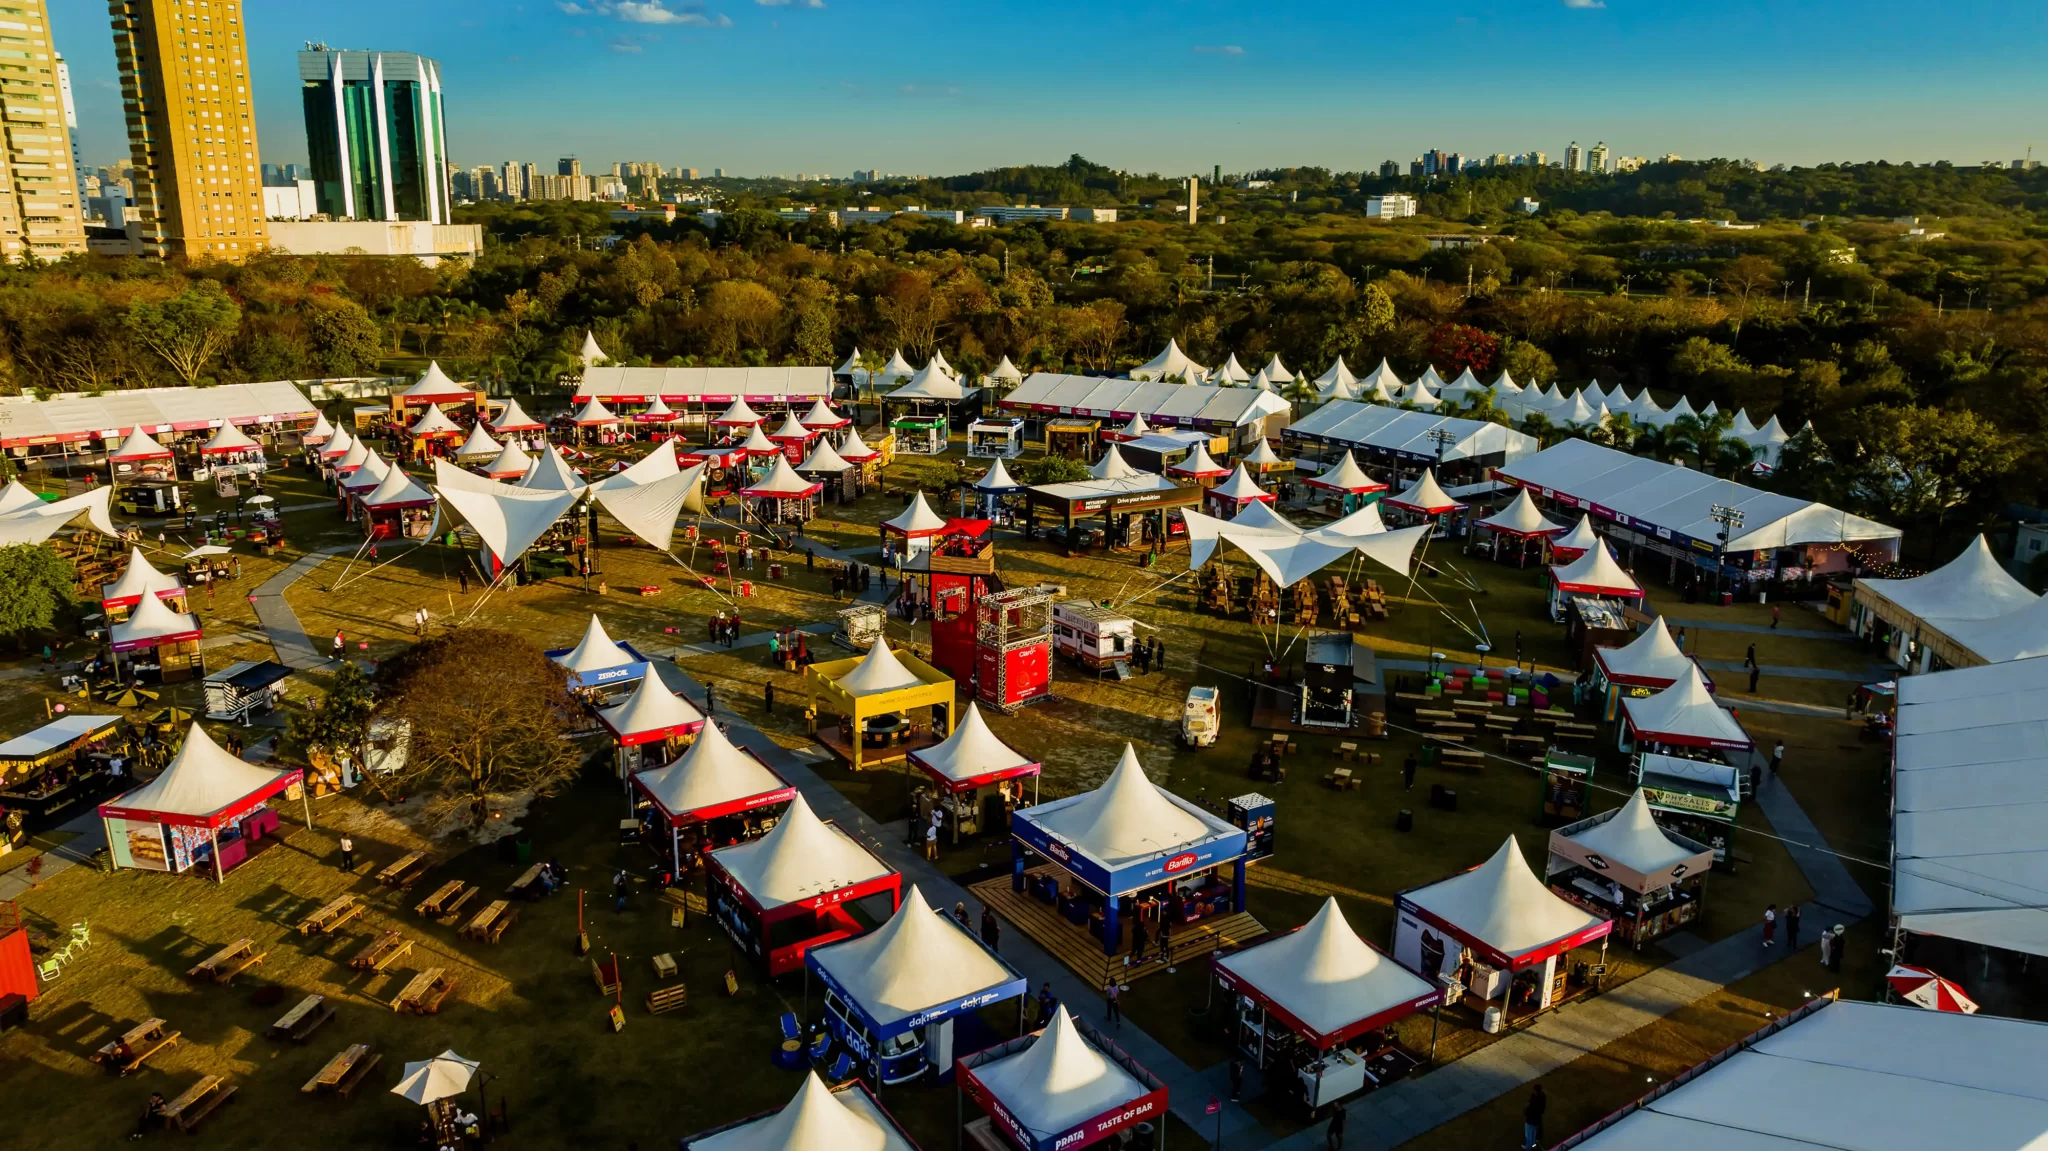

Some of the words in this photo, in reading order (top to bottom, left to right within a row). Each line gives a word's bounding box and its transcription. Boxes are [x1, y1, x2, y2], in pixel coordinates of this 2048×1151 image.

[1140, 494, 1161, 502] Ambition
[1018, 647, 1036, 658] Claro
[1665, 792, 1711, 807] PHYSALIS
[1049, 843, 1070, 861] Barilla
[1167, 857, 1194, 870] Barilla
[960, 996, 982, 1010] daki
[908, 1013, 930, 1028] daki
[846, 1030, 870, 1061] daki
[993, 1101, 1011, 1124] TASTE
[1010, 1119, 1019, 1131] OF
[1019, 1127, 1031, 1145] BAR
[1097, 1114, 1123, 1132] TASTE
[1123, 1109, 1136, 1120] OF
[1136, 1102, 1153, 1116] BAR
[1055, 1129, 1085, 1151] PRATA
